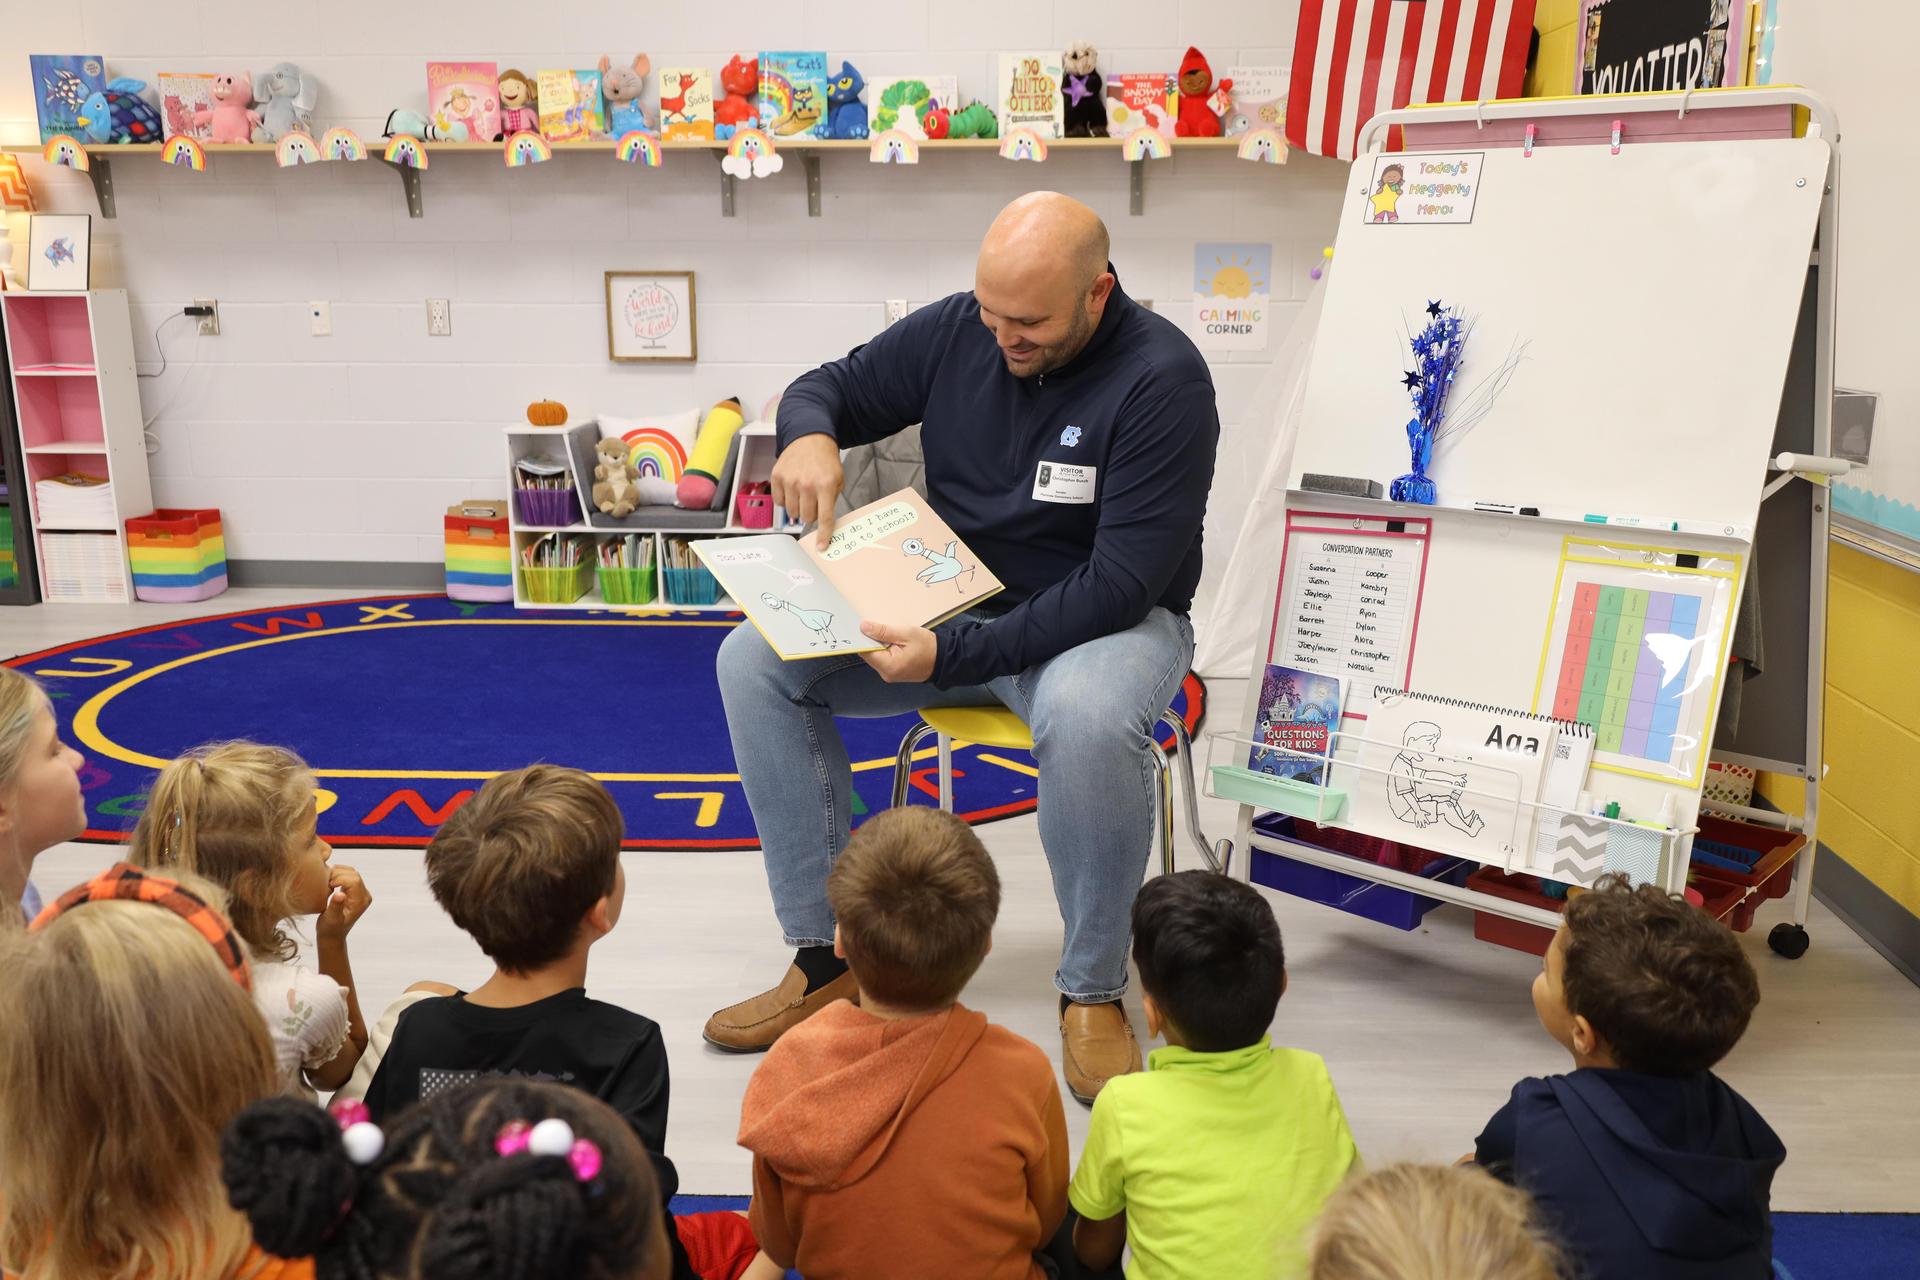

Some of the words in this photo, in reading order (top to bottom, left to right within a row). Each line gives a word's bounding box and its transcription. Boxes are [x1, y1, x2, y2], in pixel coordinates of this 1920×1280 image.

[663, 74, 677, 87] Fox
[1124, 88, 1164, 98] SNOWY
[687, 94, 711, 108] Socks
[1009, 95, 1053, 112] OTTERS
[1133, 97, 1154, 106] DAY
[1419, 161, 1469, 177] Today's
[1408, 183, 1471, 198] Heggerty
[1199, 308, 1262, 322] CALMING
[1206, 323, 1253, 335] CORNER
[849, 523, 863, 534] do
[874, 506, 900, 521] have
[827, 548, 841, 559] to
[844, 539, 858, 551] go
[860, 531, 874, 542] to
[877, 510, 915, 534] school?
[1322, 542, 1364, 556] CONVERSATION
[1364, 546, 1394, 559] PARTNERS
[1303, 602, 1323, 612] Ellie
[1359, 608, 1377, 619] Ryan
[1298, 615, 1325, 625] Barrett
[1297, 627, 1322, 638] Harper
[1355, 622, 1376, 632] Dylan
[1350, 648, 1391, 662] Christopher
[1347, 662, 1375, 673] Natalie
[1267, 730, 1325, 740] QUESTIONS
[1273, 740, 1292, 750] FOR
[1295, 740, 1317, 750] KIDS
